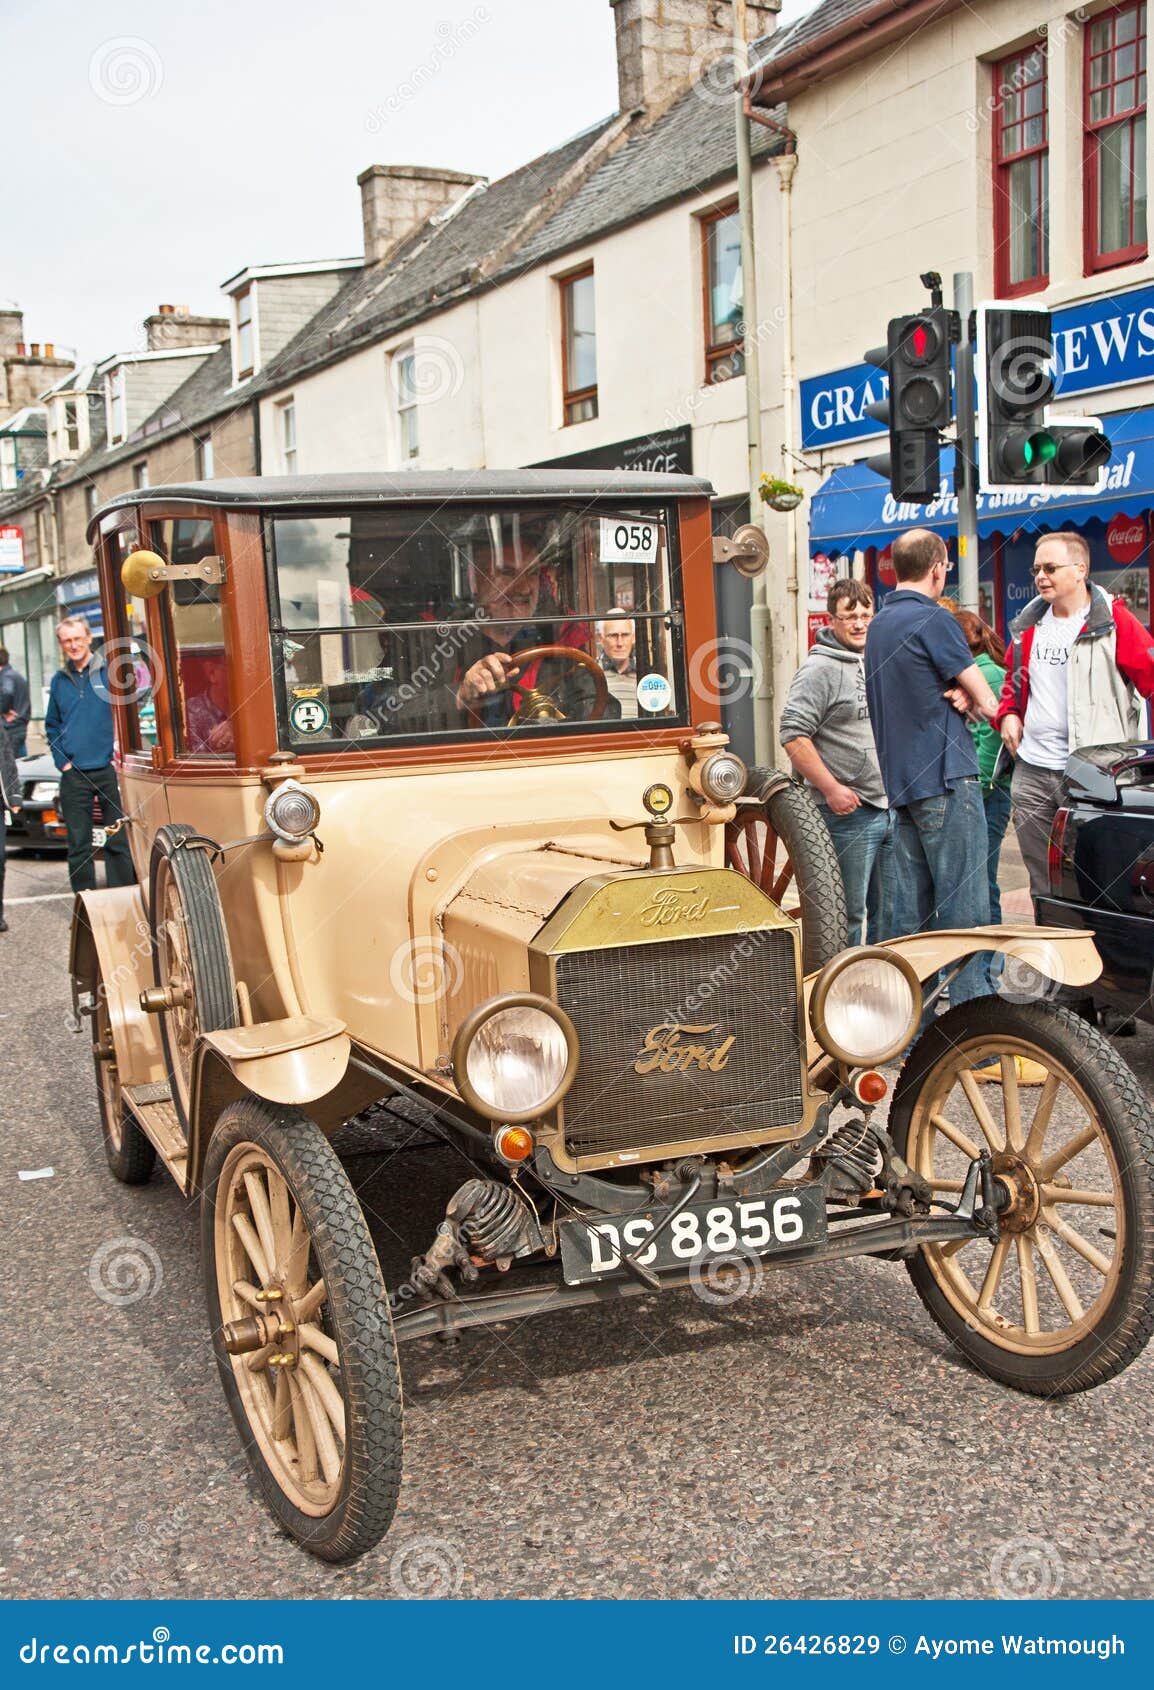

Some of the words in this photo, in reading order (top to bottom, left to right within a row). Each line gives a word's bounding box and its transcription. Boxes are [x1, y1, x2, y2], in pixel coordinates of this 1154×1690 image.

[614, 526, 652, 551] 058
[640, 879, 709, 928] Ford
[634, 1023, 737, 1075] Ford
[586, 1218, 658, 1273] DS
[670, 1196, 804, 1259] 8856
